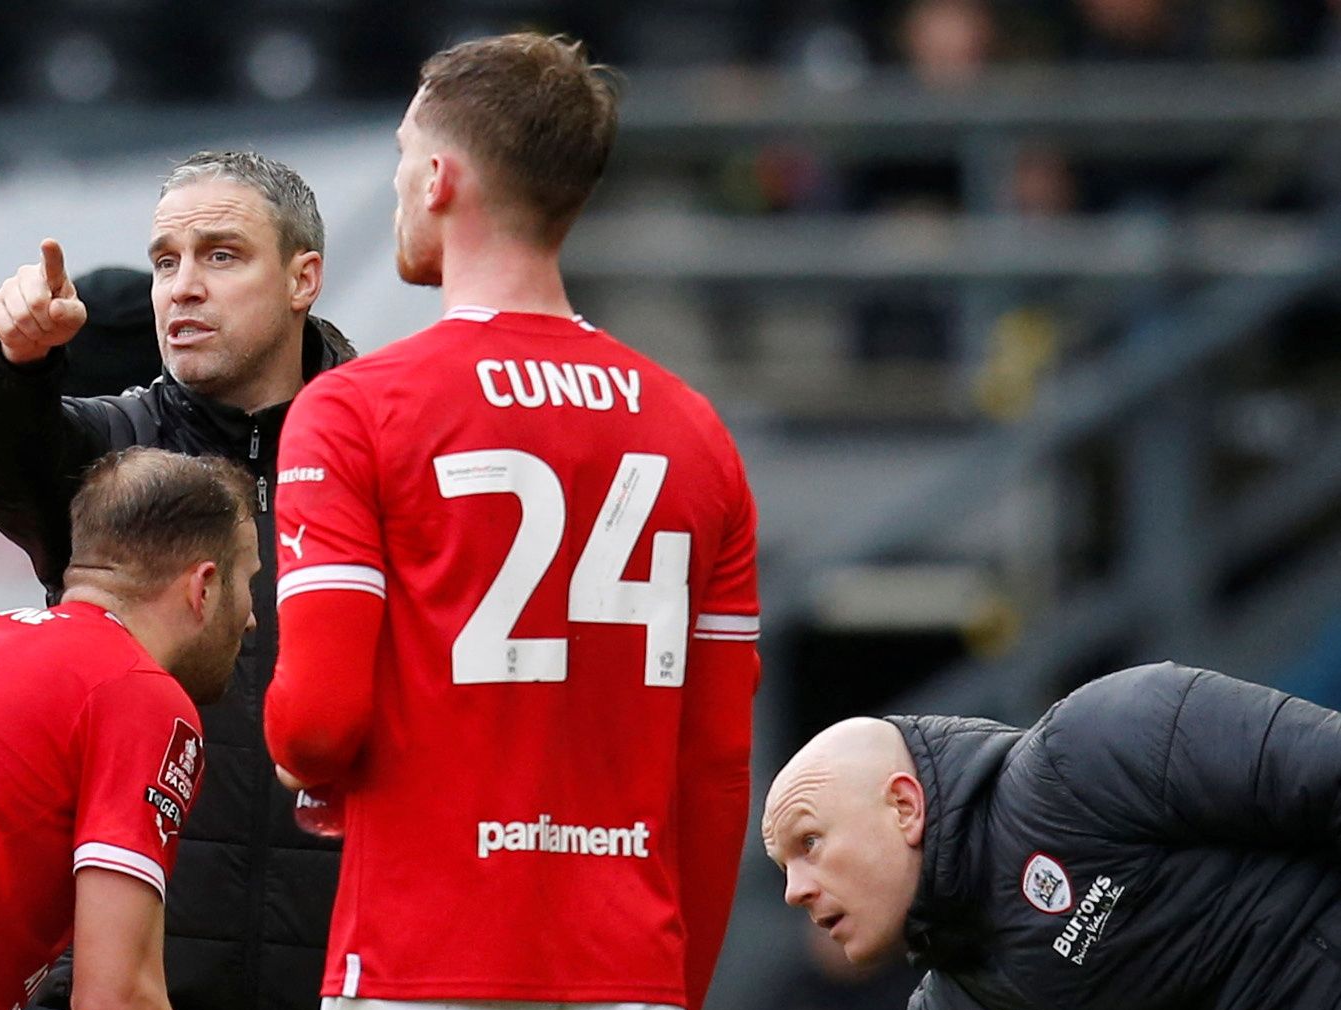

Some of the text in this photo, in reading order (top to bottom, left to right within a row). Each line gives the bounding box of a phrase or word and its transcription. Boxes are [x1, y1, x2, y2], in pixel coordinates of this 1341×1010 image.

[476, 358, 641, 414] CUNDY
[432, 447, 692, 688] 24
[477, 813, 651, 859] parliament
[1052, 875, 1113, 958] Burrows
